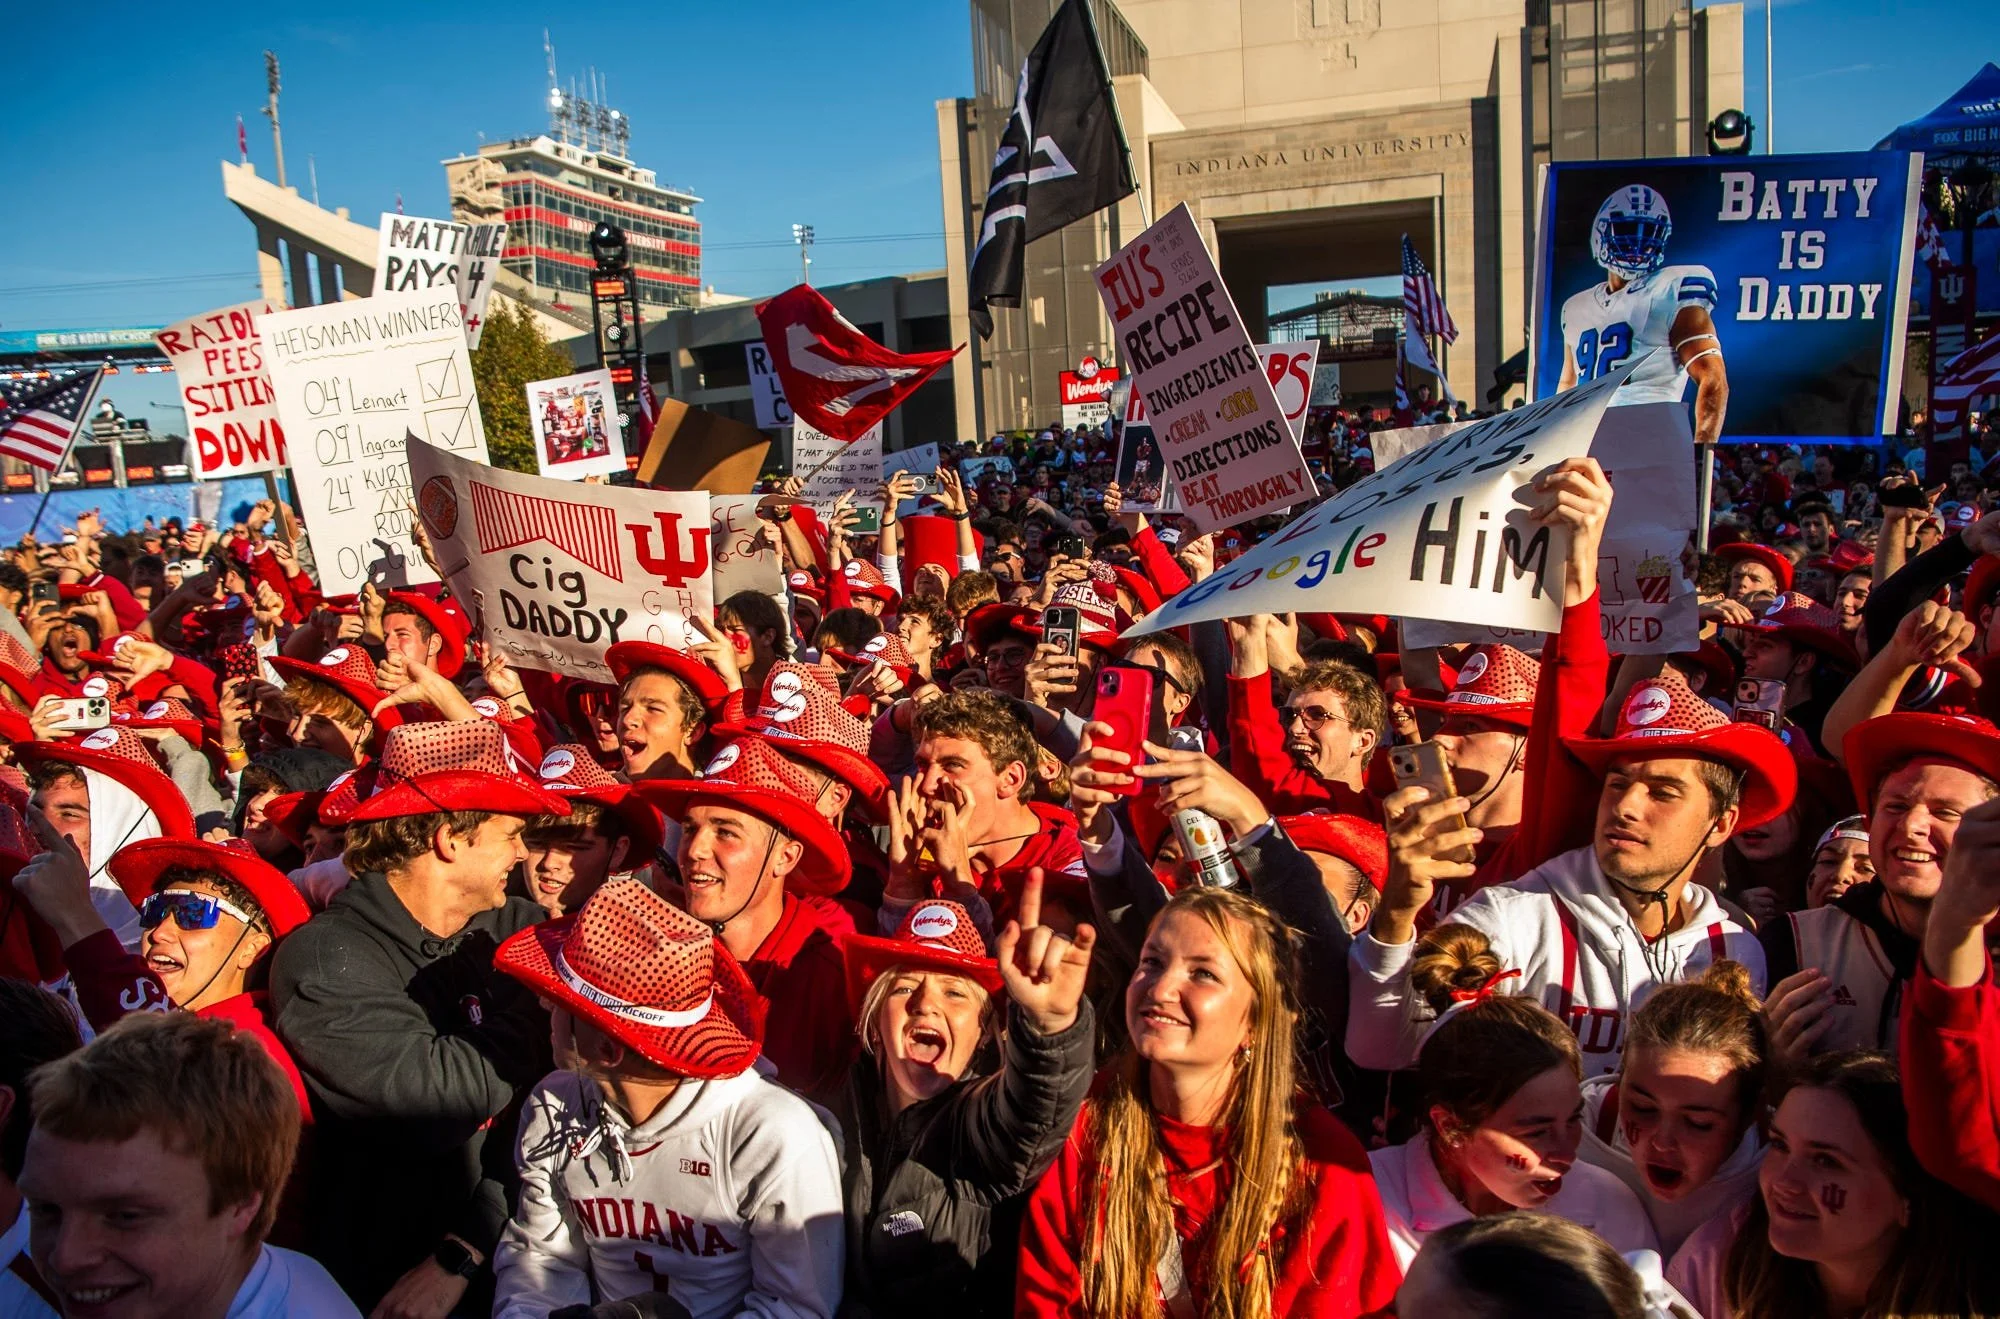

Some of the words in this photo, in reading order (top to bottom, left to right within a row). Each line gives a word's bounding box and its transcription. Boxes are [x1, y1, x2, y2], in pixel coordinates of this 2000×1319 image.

[1175, 151, 1289, 176] INDIANA
[1302, 131, 1471, 163] UNIVERSITY
[1933, 131, 1960, 144] FOX
[1964, 127, 1986, 142] BIG
[390, 219, 464, 254] MATT
[1778, 230, 1826, 270] IS
[385, 256, 460, 292] PAYS
[1100, 242, 1165, 323] IU'S
[272, 315, 372, 358] HEISMAN
[373, 302, 461, 340] WINNERS
[1125, 280, 1232, 375] RECIPE
[203, 342, 262, 377] PEES
[1146, 343, 1259, 417] INGREDIENTS
[348, 377, 408, 412] Leinart
[1172, 420, 1283, 482] DIRECTIONS
[1181, 473, 1222, 507] BEAT
[1206, 468, 1306, 521] THOROUGHLY
[624, 511, 711, 588] IU
[1175, 524, 1387, 610] Google
[509, 553, 588, 608] Cig
[499, 588, 628, 646] DADDY
[914, 915, 953, 928] Wendy's
[580, 983, 596, 1000] BIG
[621, 1006, 666, 1023] KICKOFF
[570, 1196, 739, 1257] NDIANA
[889, 1211, 907, 1220] THE
